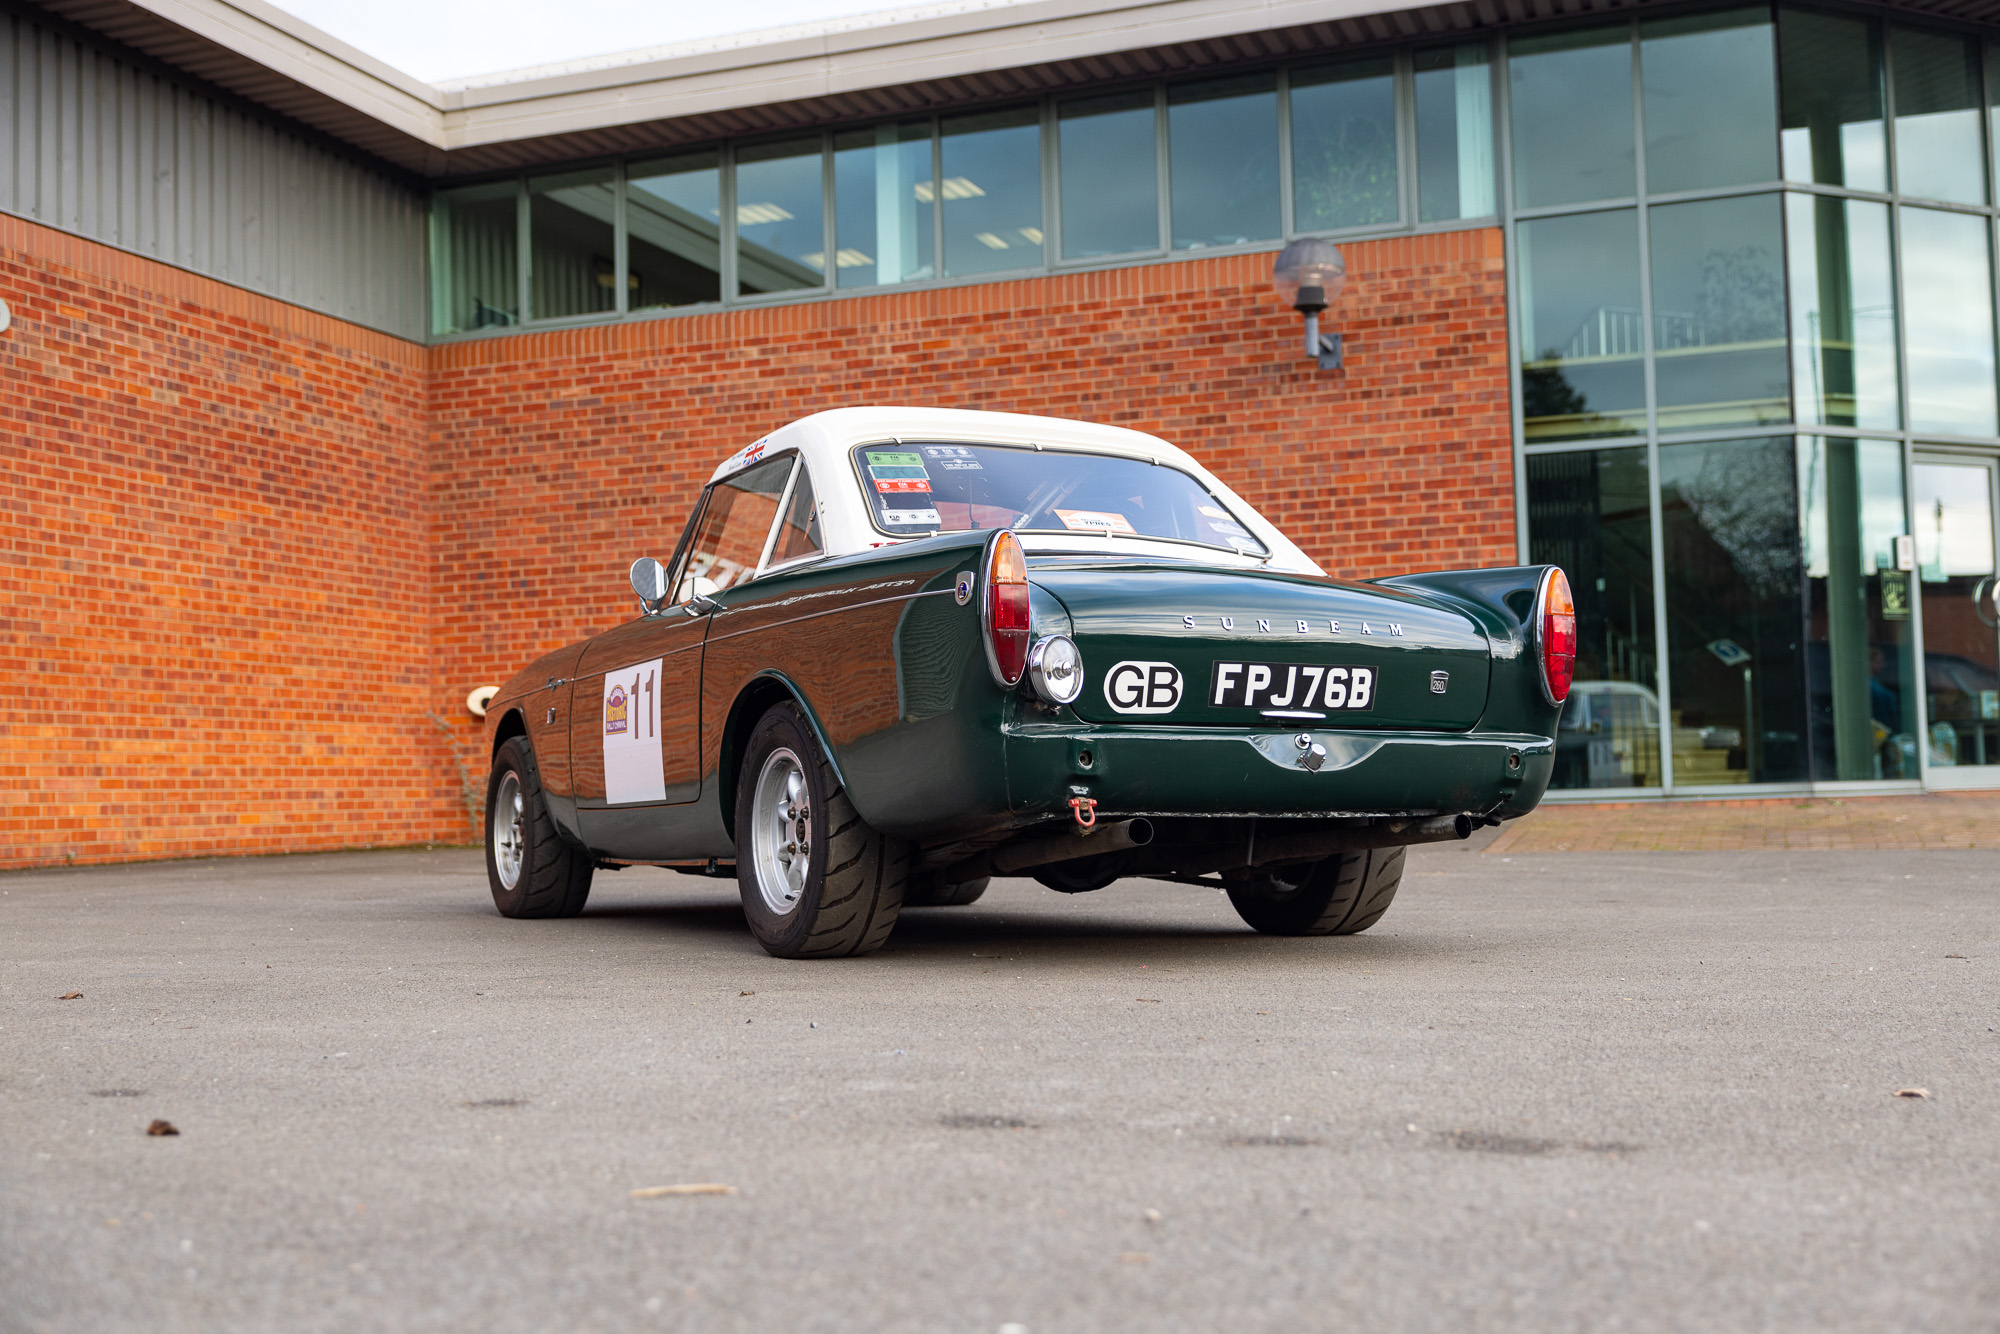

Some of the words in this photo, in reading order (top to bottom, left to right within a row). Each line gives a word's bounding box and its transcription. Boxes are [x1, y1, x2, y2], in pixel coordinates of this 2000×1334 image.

[1183, 615, 1403, 636] SUNBEAM
[631, 670, 654, 739] 11
[1109, 665, 1178, 707] GB
[1214, 663, 1373, 708] FPJ76B
[1432, 680, 1444, 691] 260
